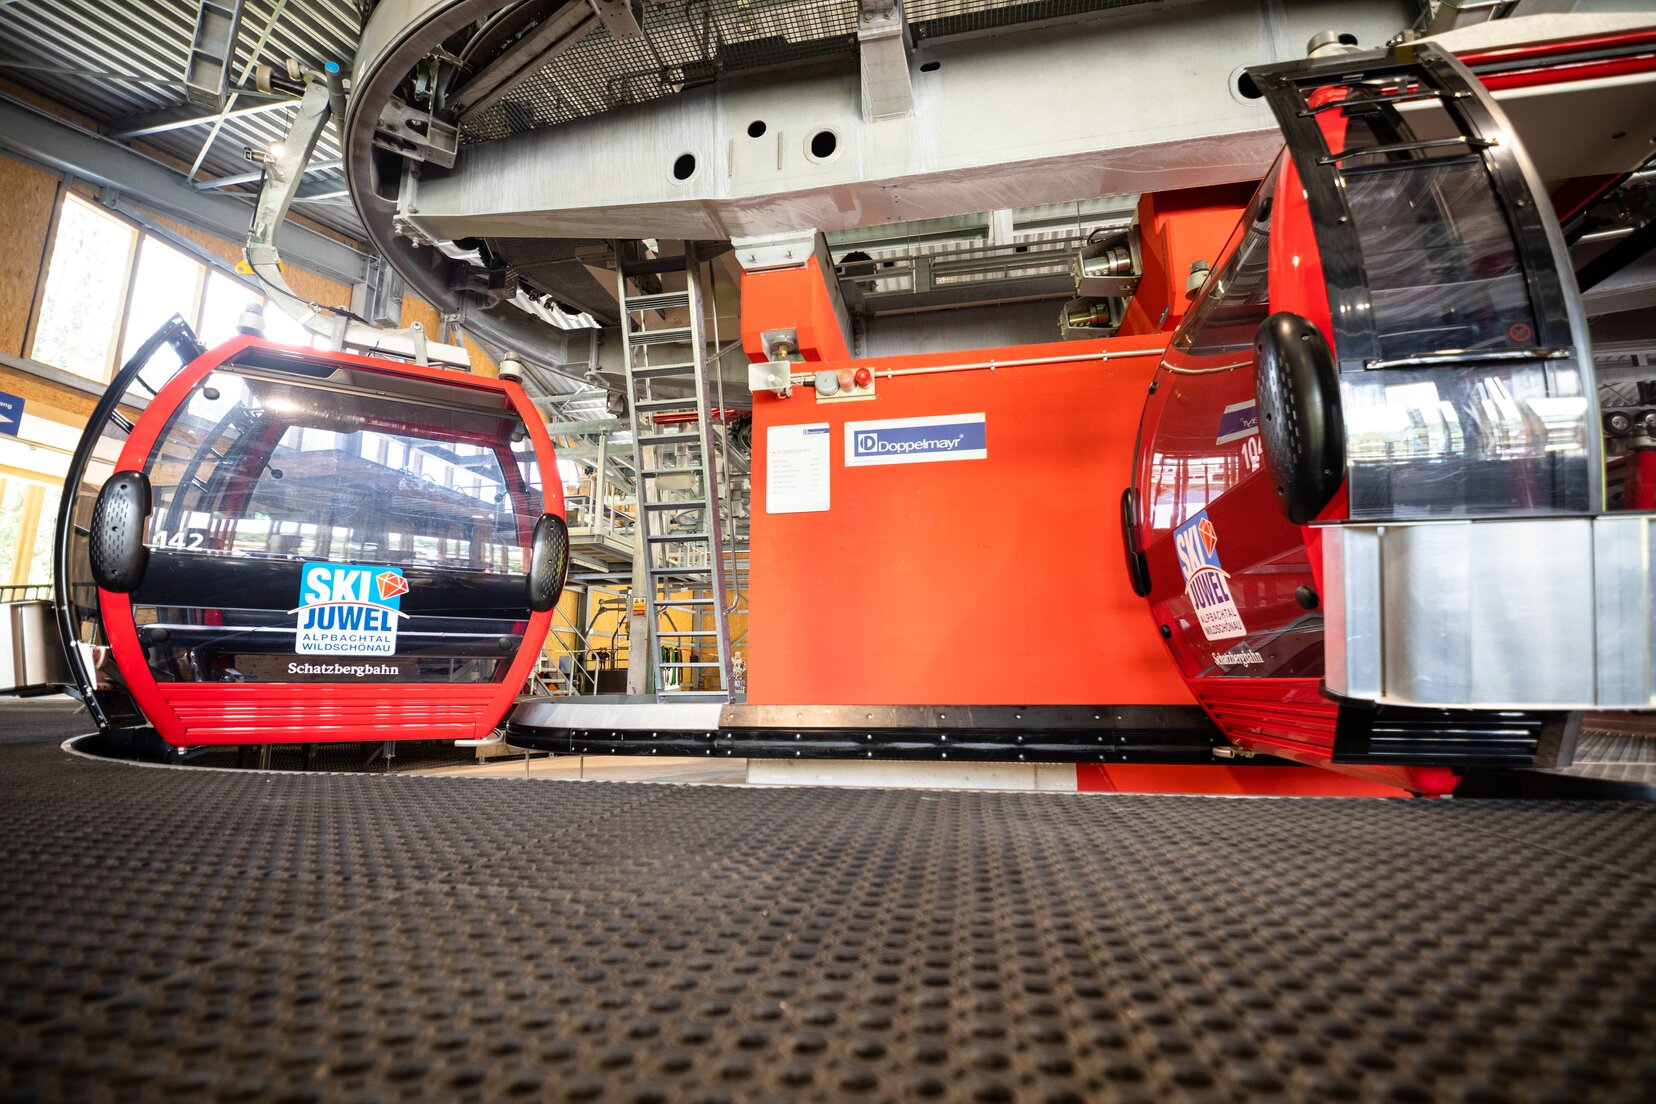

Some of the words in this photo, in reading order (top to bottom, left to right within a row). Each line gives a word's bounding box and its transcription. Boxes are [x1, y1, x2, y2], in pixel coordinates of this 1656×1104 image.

[878, 438, 961, 454] Doppelmayr
[153, 531, 204, 551] 142
[1176, 524, 1206, 579] SKI
[304, 567, 372, 604] SKI
[1190, 571, 1230, 610] JUWEL
[303, 605, 392, 631] JUWEL
[1200, 607, 1237, 623] ALPBACHTAL
[1205, 620, 1242, 636] WILDSCHÖNAU
[302, 633, 391, 643] ALPBACHTAL
[302, 642, 391, 652] WILDSCHÖNAU
[1211, 649, 1264, 667] Schatzbergbahn
[288, 662, 399, 677] Schatzbergbahn
